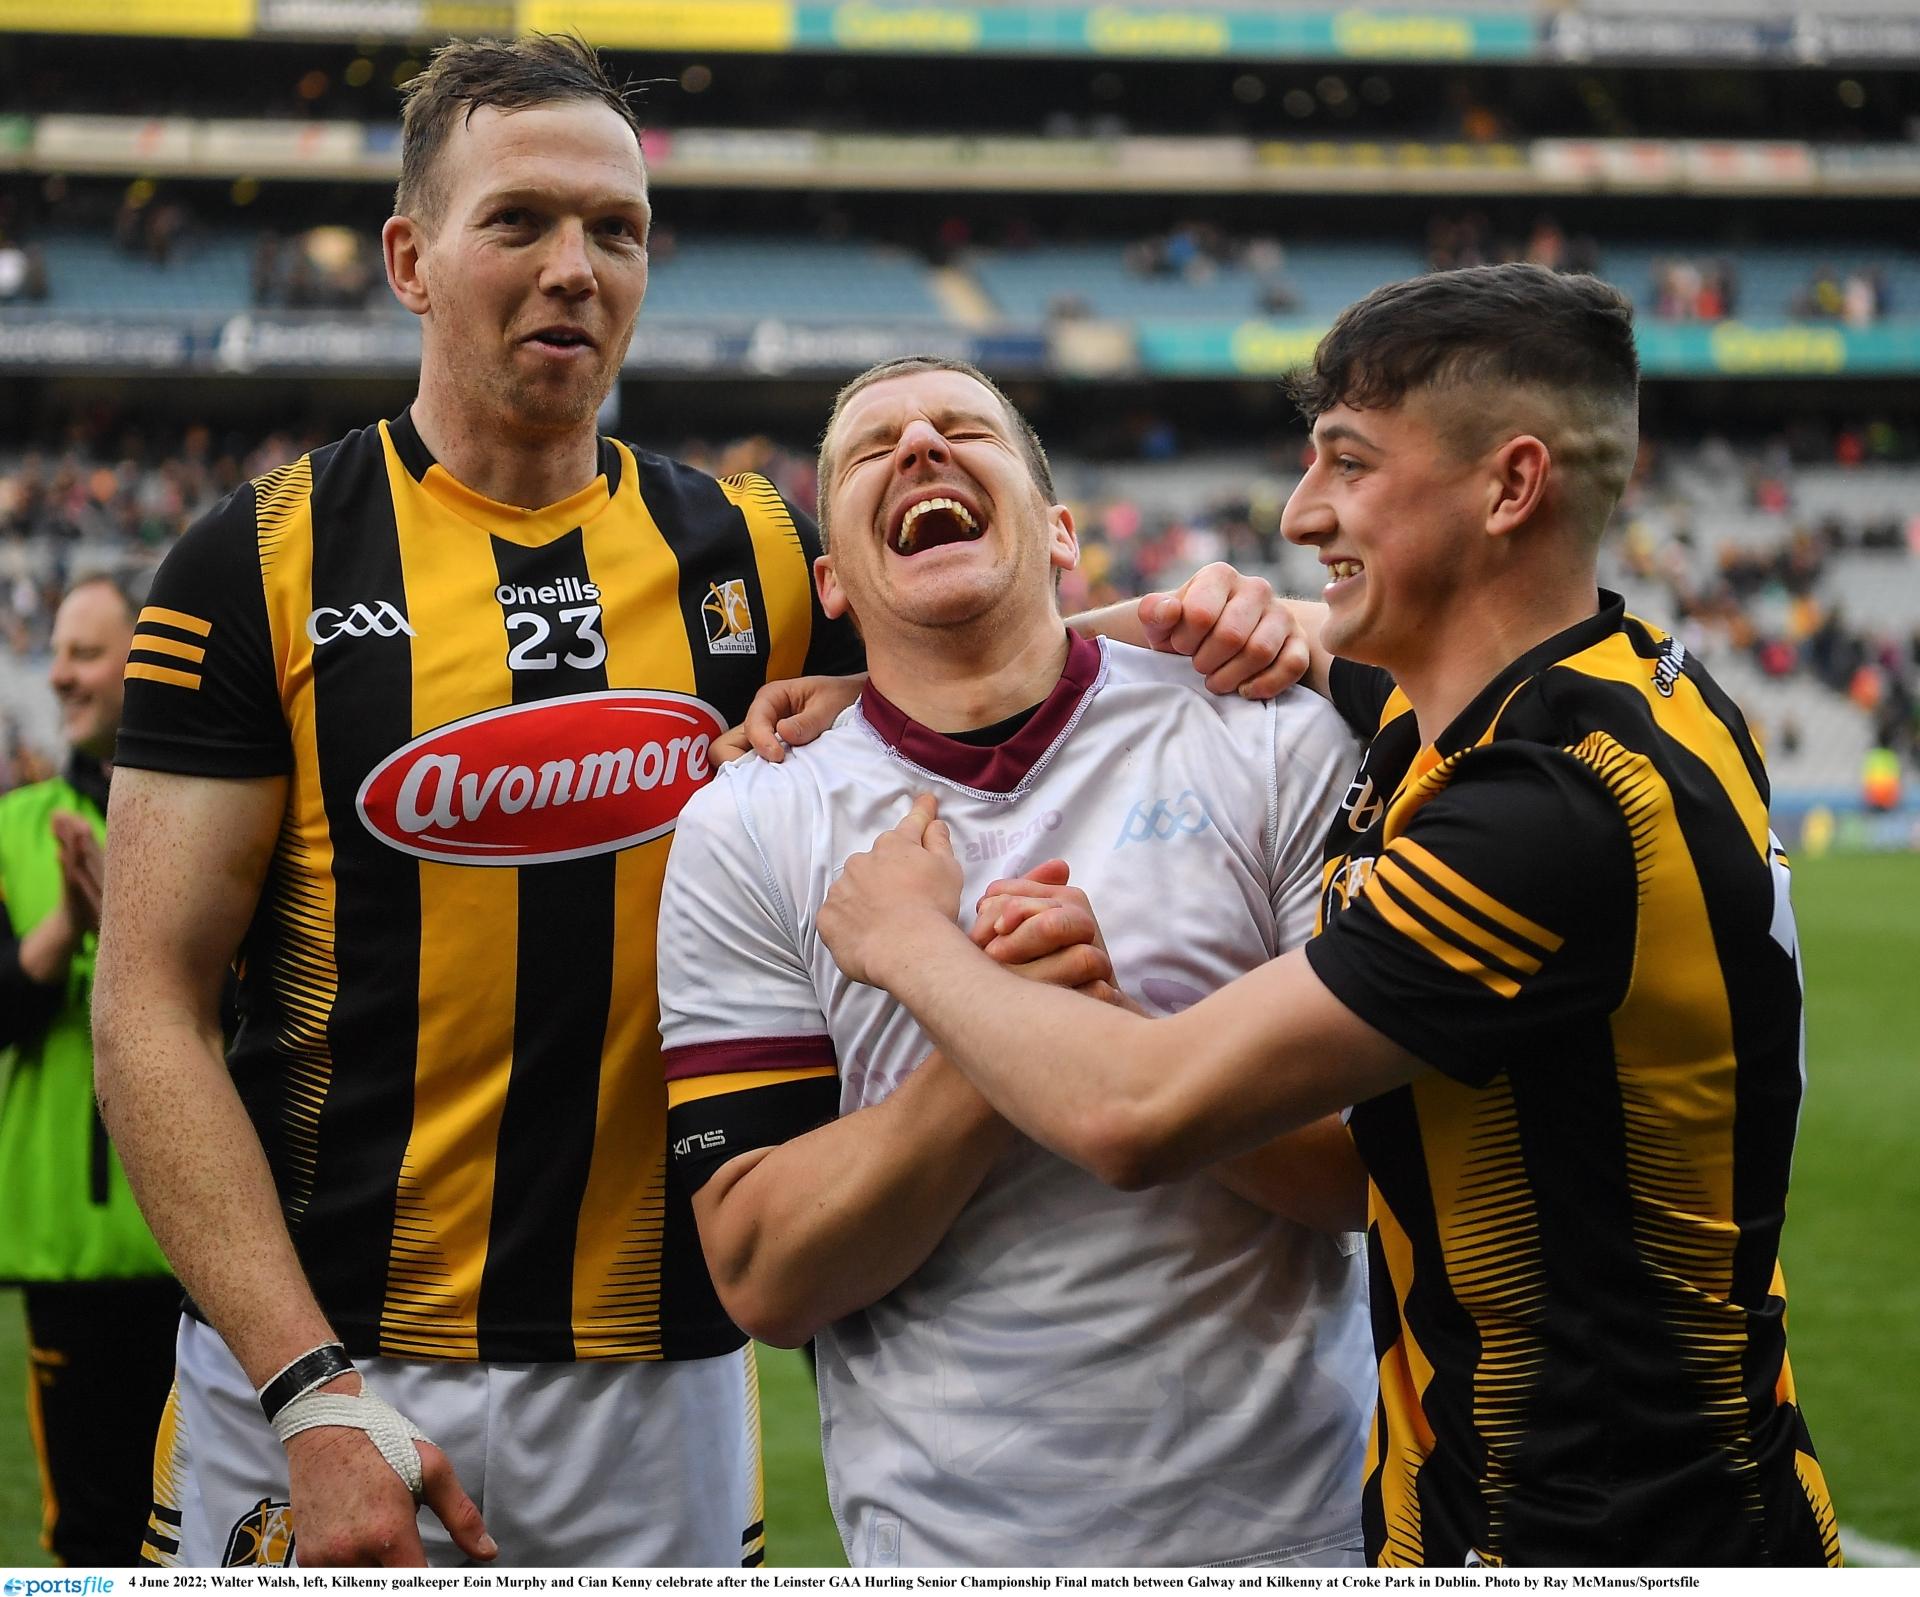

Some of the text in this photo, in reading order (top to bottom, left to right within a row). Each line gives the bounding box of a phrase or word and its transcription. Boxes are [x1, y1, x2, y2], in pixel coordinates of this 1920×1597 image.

[506, 605, 608, 670] 23
[735, 631, 754, 643] Cill
[711, 642, 755, 653] Chainnigh
